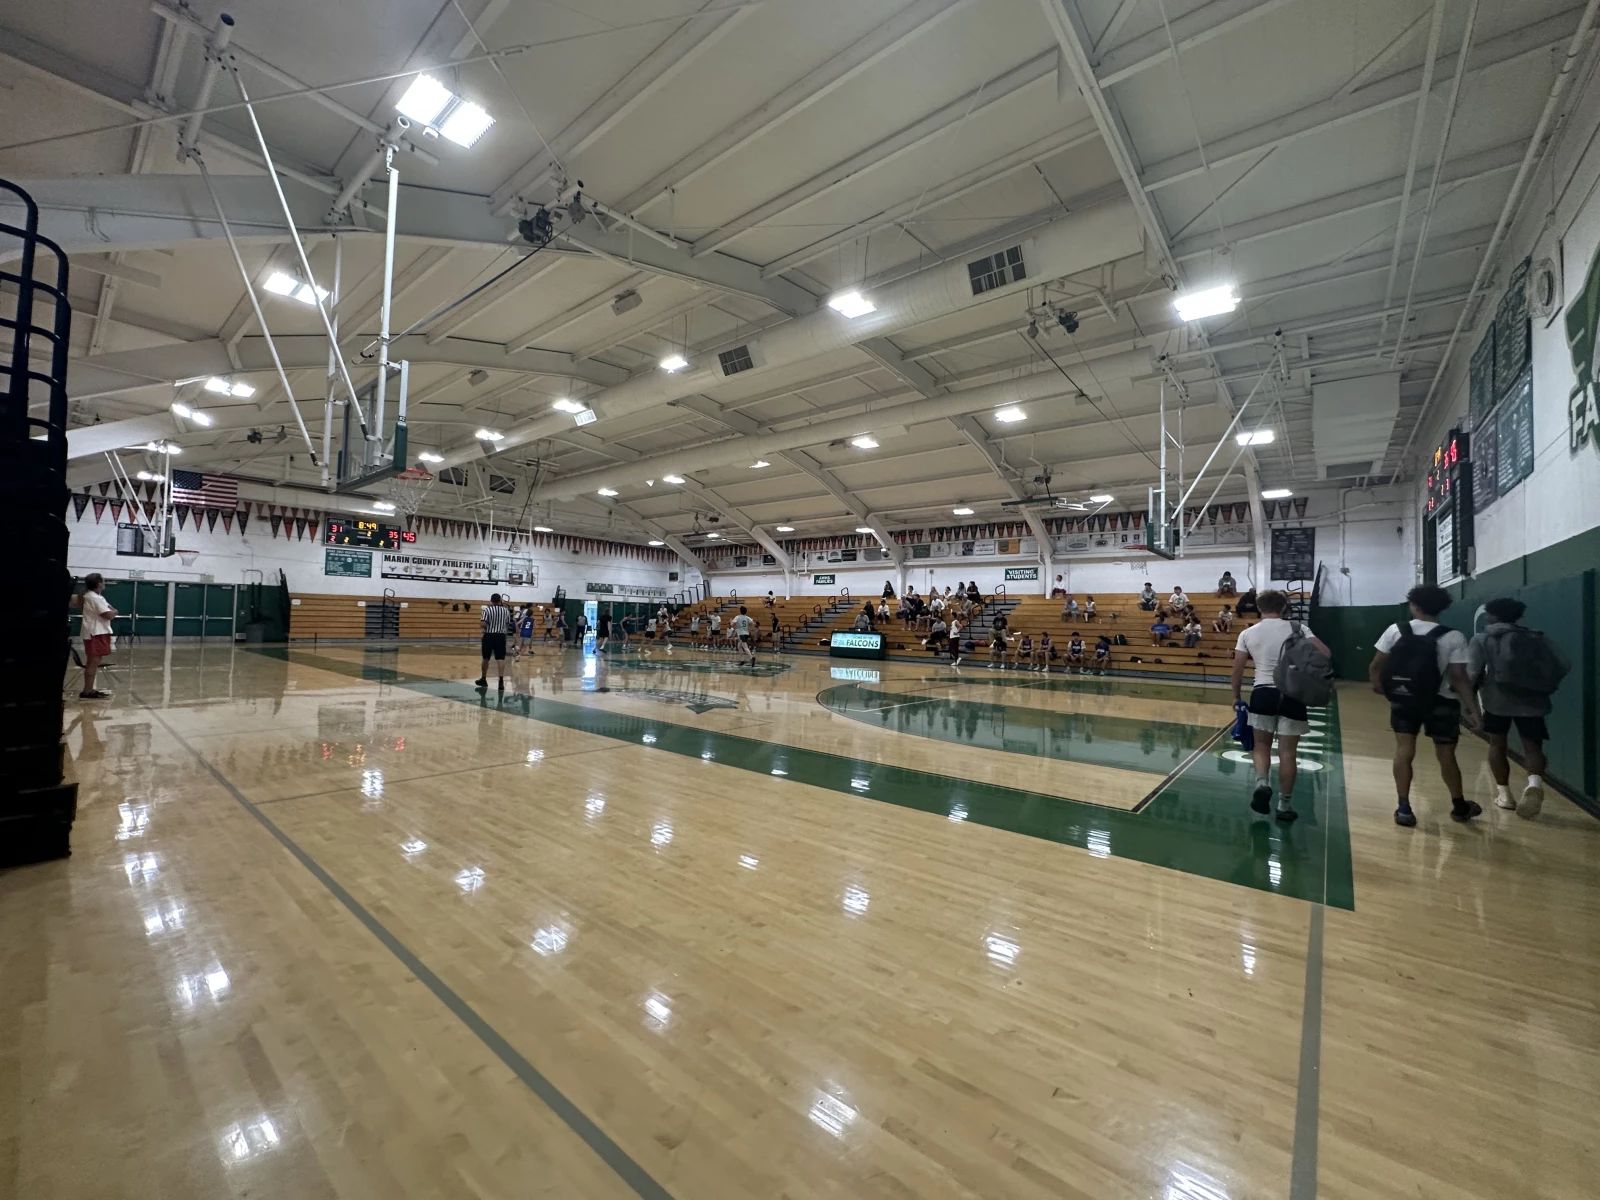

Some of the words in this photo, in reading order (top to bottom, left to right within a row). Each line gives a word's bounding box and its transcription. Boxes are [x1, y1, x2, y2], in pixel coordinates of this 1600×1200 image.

[389, 531, 399, 539] 35
[402, 532, 415, 542] 45
[384, 554, 410, 563] MARIN
[412, 557, 441, 567] COUNTY
[443, 560, 473, 569] ATHLETIC
[525, 621, 531, 629] 2
[846, 639, 879, 648] FALCONS
